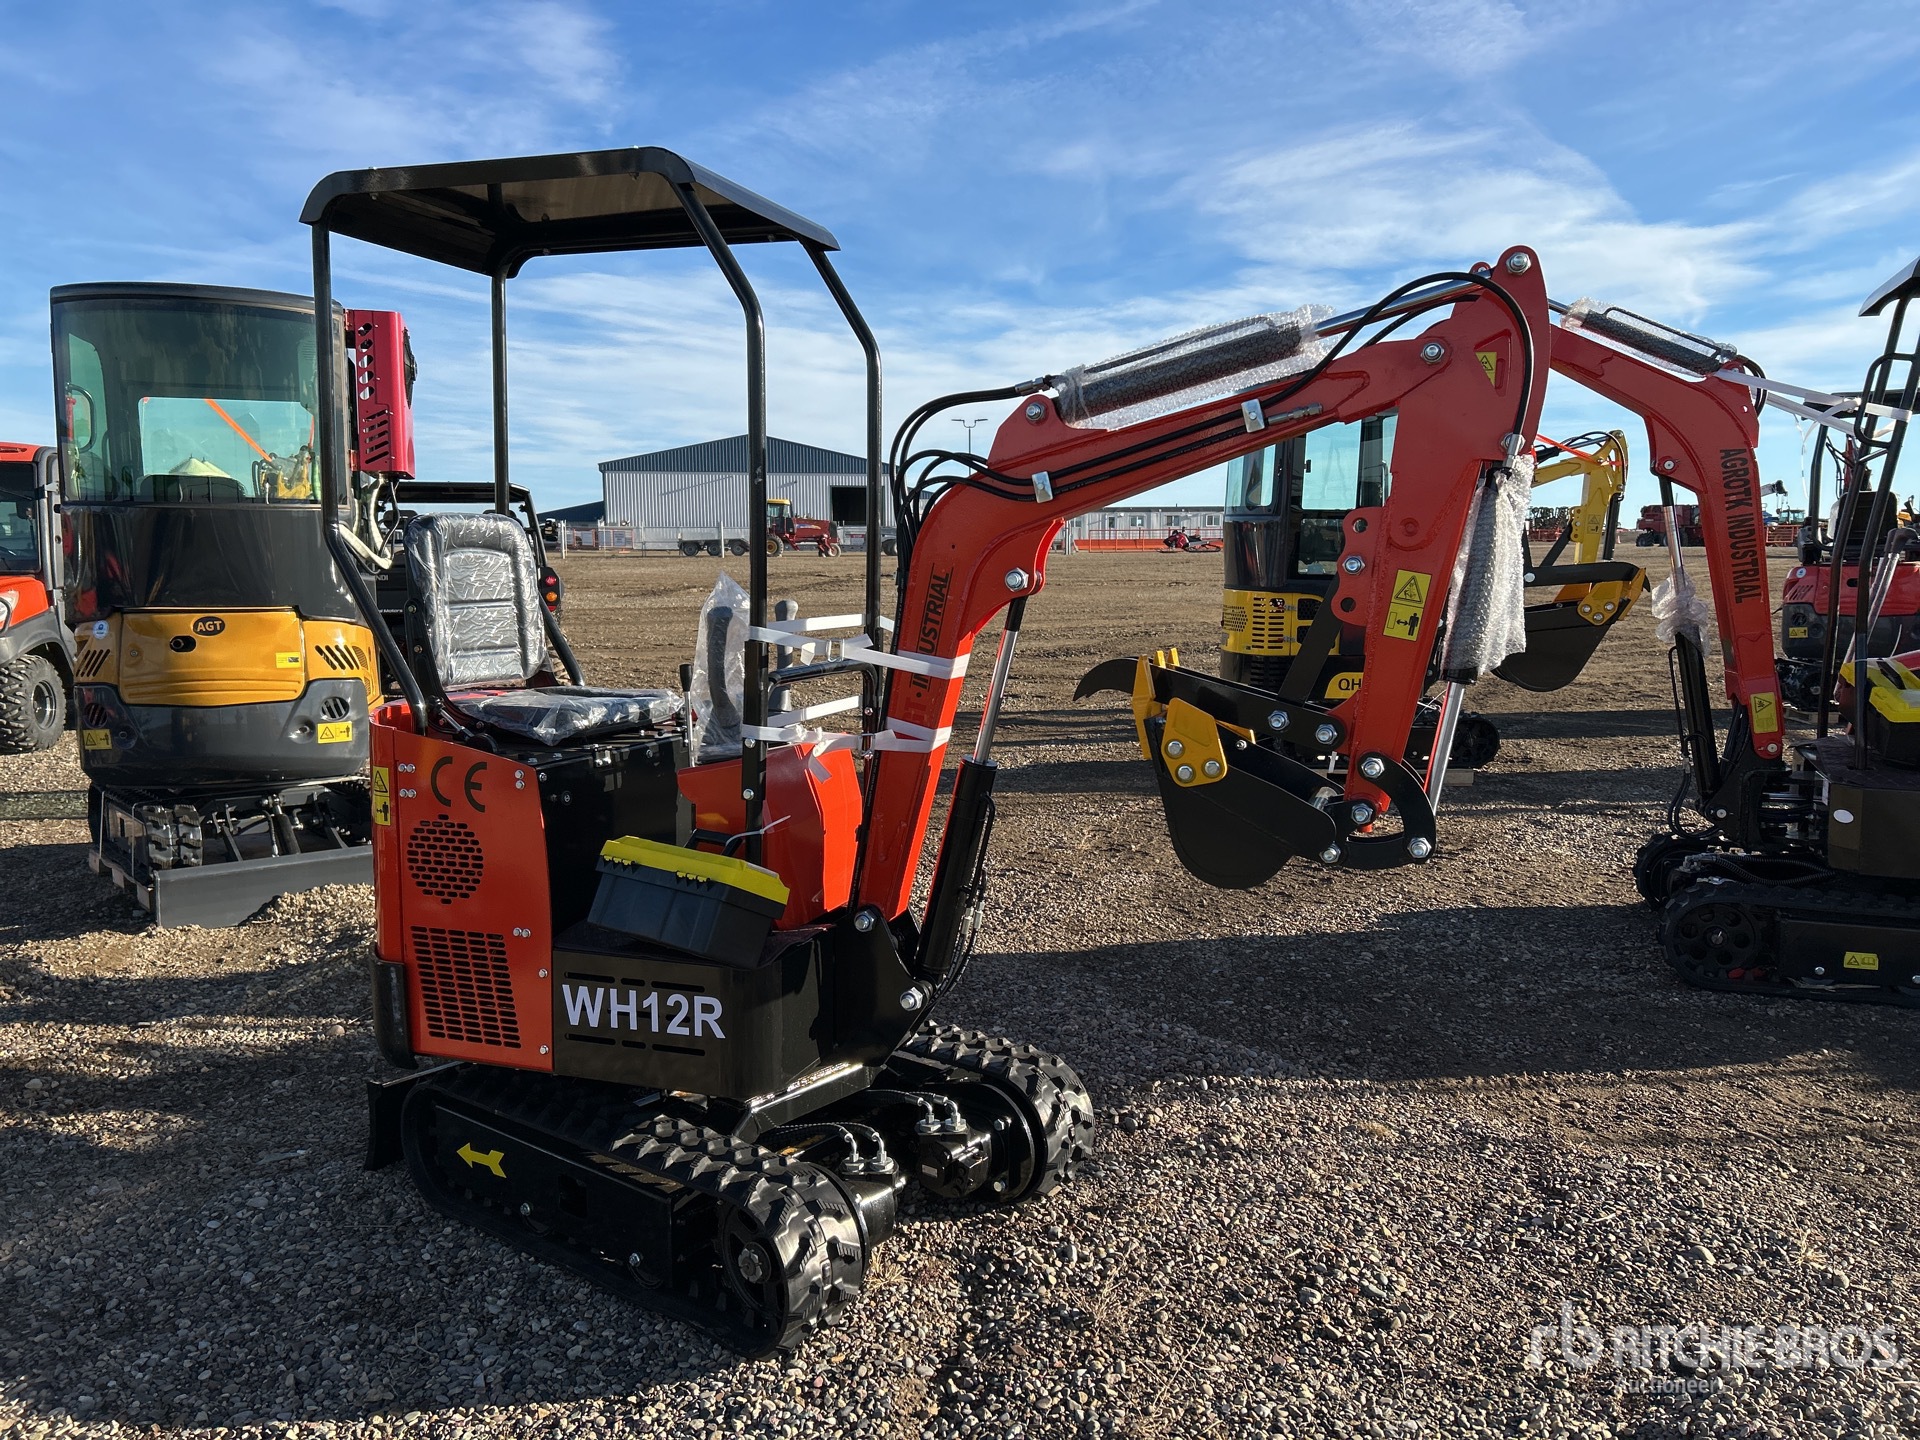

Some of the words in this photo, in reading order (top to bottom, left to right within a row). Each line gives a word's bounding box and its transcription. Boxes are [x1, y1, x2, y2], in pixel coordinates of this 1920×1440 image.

[1720, 449, 1752, 511] AGROTK
[1727, 513, 1761, 604] INDUSTRIAL
[197, 621, 222, 632] AGT
[430, 755, 488, 813] CE
[561, 984, 726, 1039] WH12R
